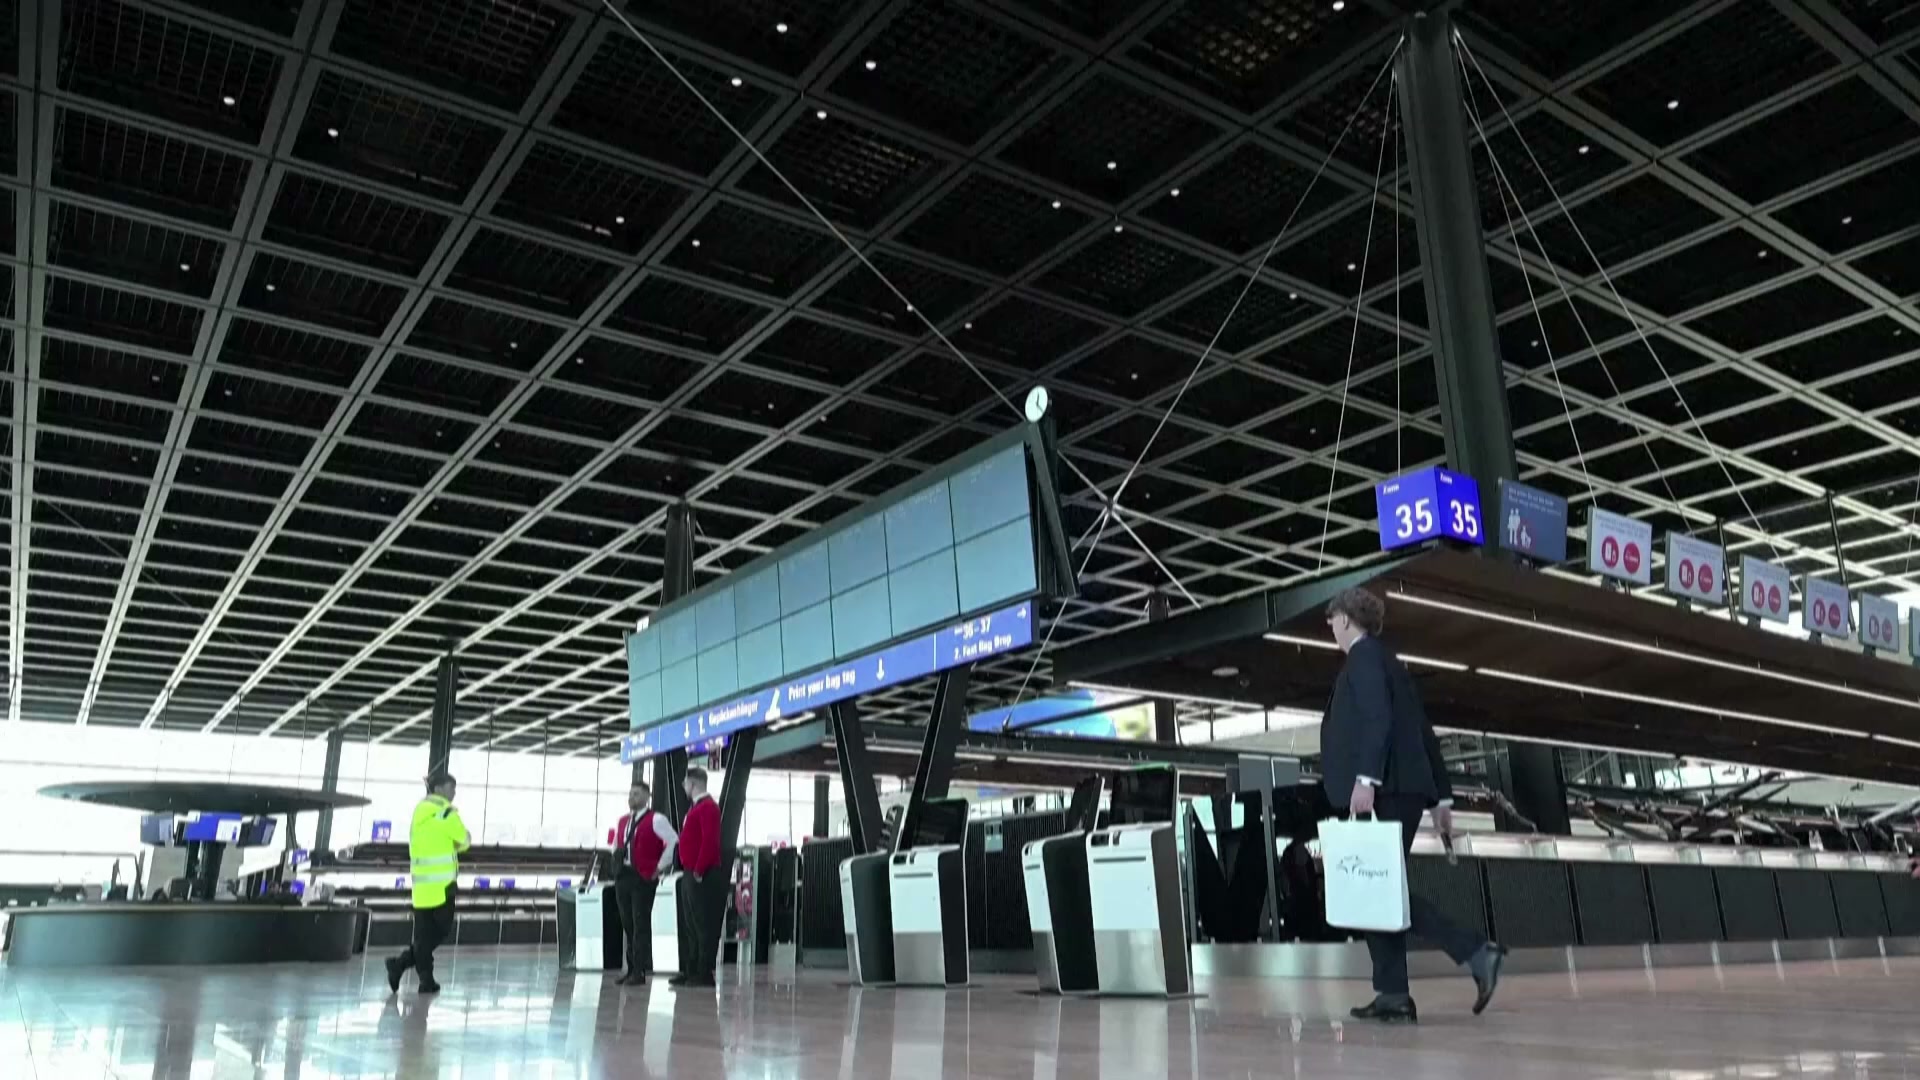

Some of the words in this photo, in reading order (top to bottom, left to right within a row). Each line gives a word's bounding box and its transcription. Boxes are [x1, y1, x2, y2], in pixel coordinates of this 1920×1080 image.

[1395, 497, 1433, 539] 35
[1450, 499, 1478, 538] 35
[788, 684, 806, 702] Print
[807, 679, 824, 699] your
[825, 673, 841, 691] bag
[841, 669, 856, 687] tag
